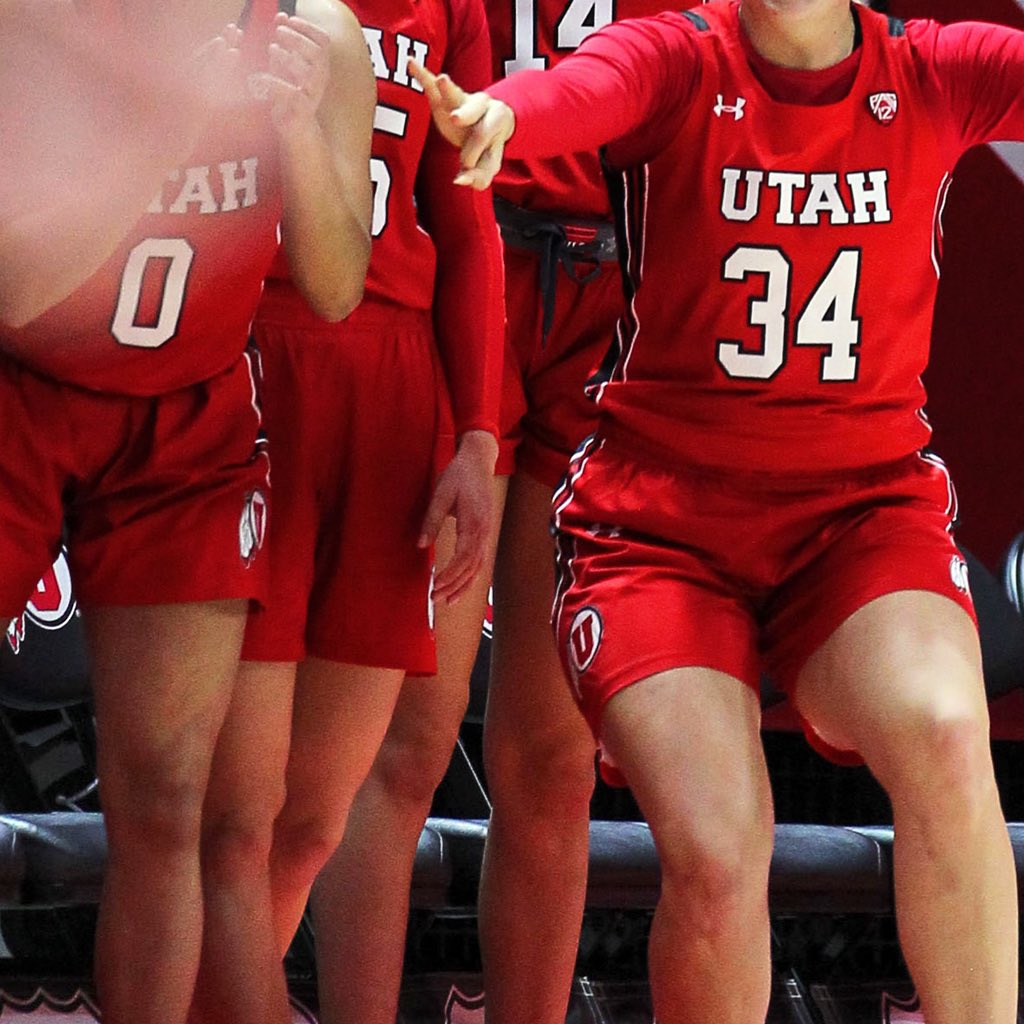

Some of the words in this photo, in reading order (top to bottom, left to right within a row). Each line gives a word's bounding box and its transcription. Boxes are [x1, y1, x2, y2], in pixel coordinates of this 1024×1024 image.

[721, 168, 891, 225] UTAH
[110, 237, 195, 348] 0
[718, 246, 861, 381] 34
